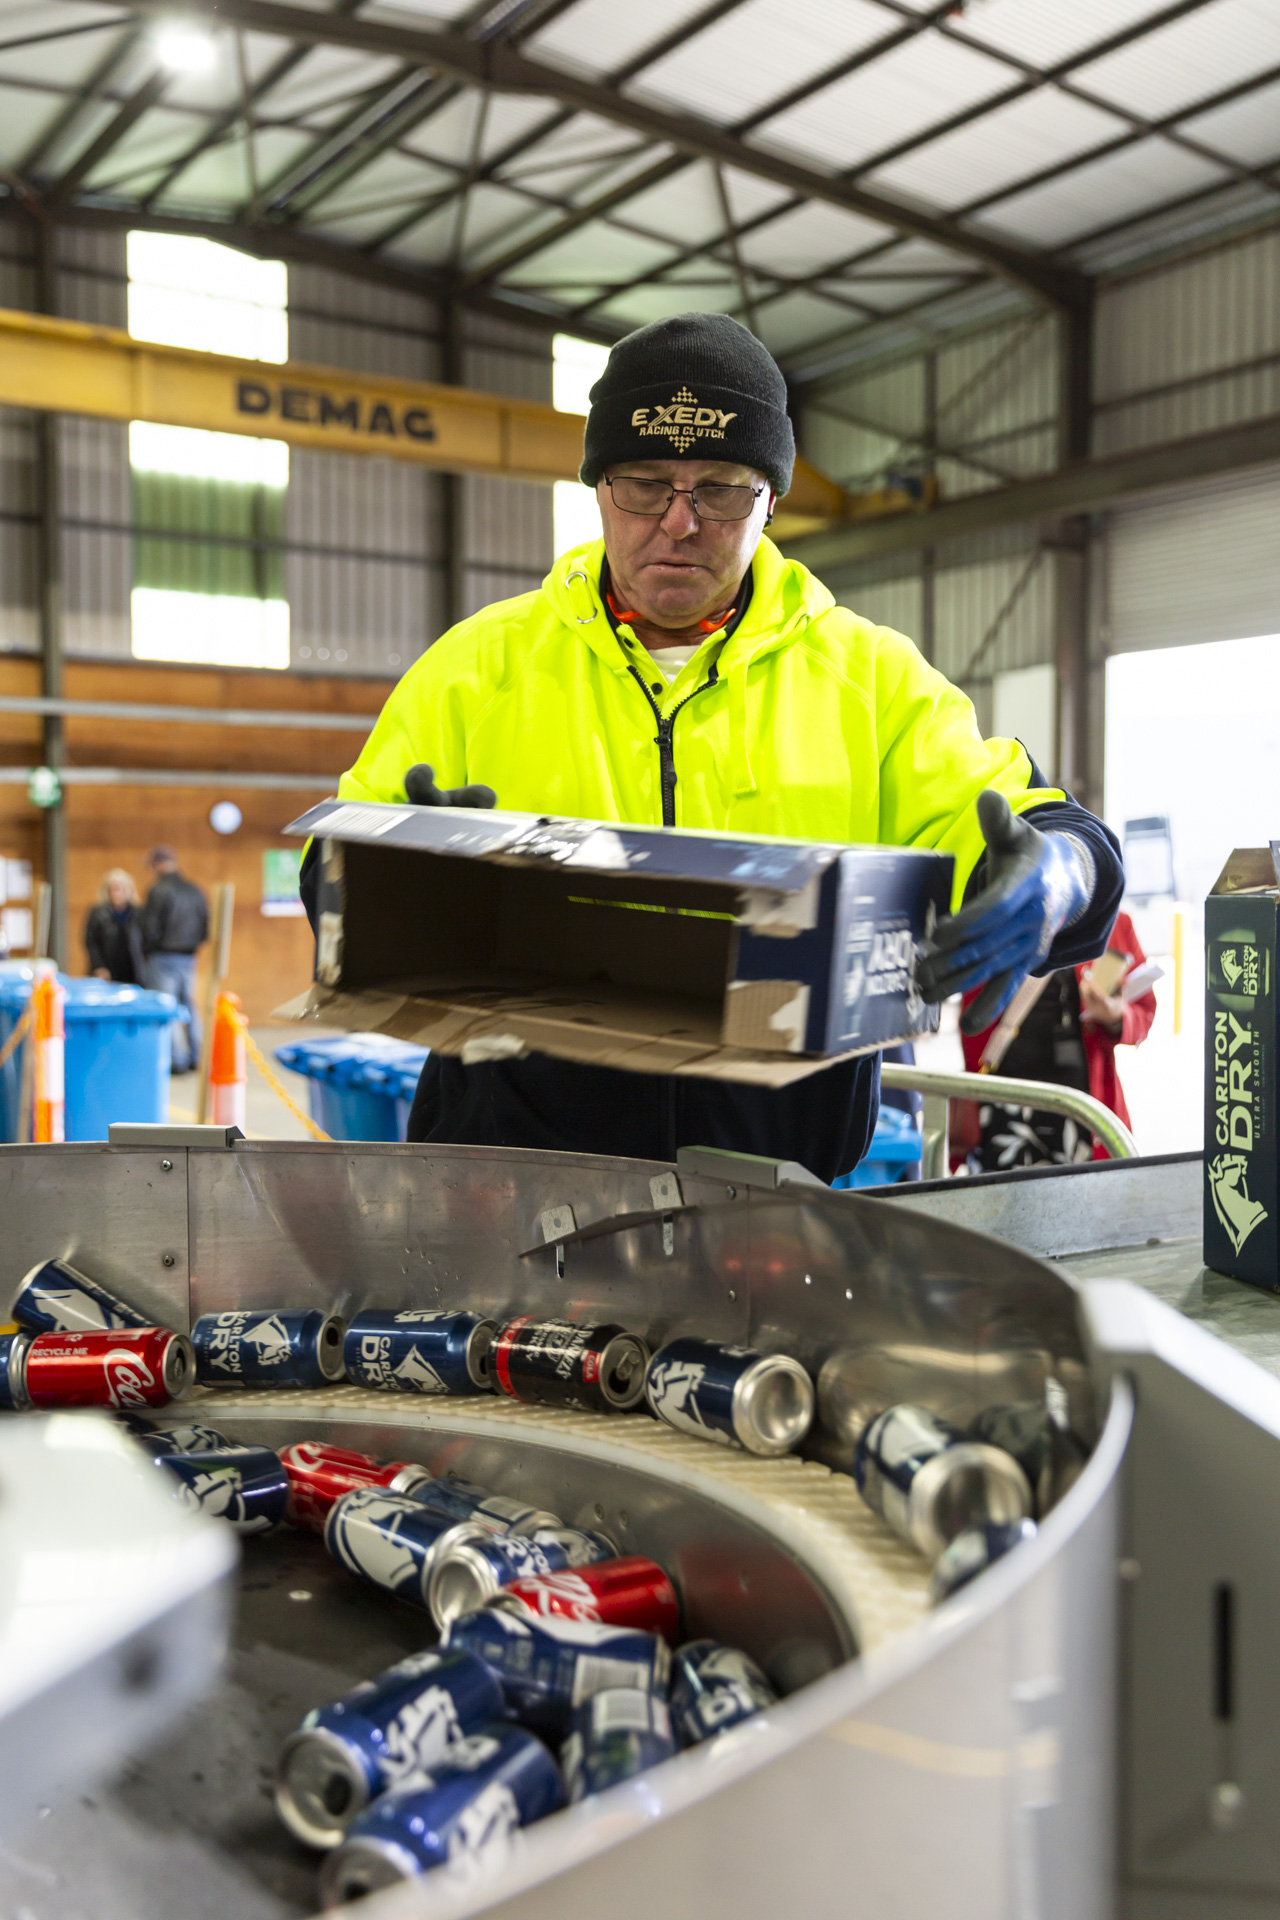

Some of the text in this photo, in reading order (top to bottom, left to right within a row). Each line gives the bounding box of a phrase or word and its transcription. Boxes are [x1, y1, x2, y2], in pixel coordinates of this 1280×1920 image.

[236, 379, 437, 442] DEMAG
[631, 403, 738, 428] EXEDY
[639, 425, 725, 440] RACING CLUTCH
[1242, 945, 1250, 995] CARLTON
[1248, 945, 1259, 996] DRY
[1214, 1010, 1230, 1146] CARLTON
[1228, 1010, 1253, 1152] DRY
[1253, 1031, 1261, 1140] ULTRA SMOOTH
[31, 1346, 89, 1356] RECYCLE ME
[209, 1311, 239, 1373] DRY
[228, 1311, 253, 1373] CARLTON
[379, 1335, 402, 1390] CARLTO
[584, 1354, 598, 1380] COLA
